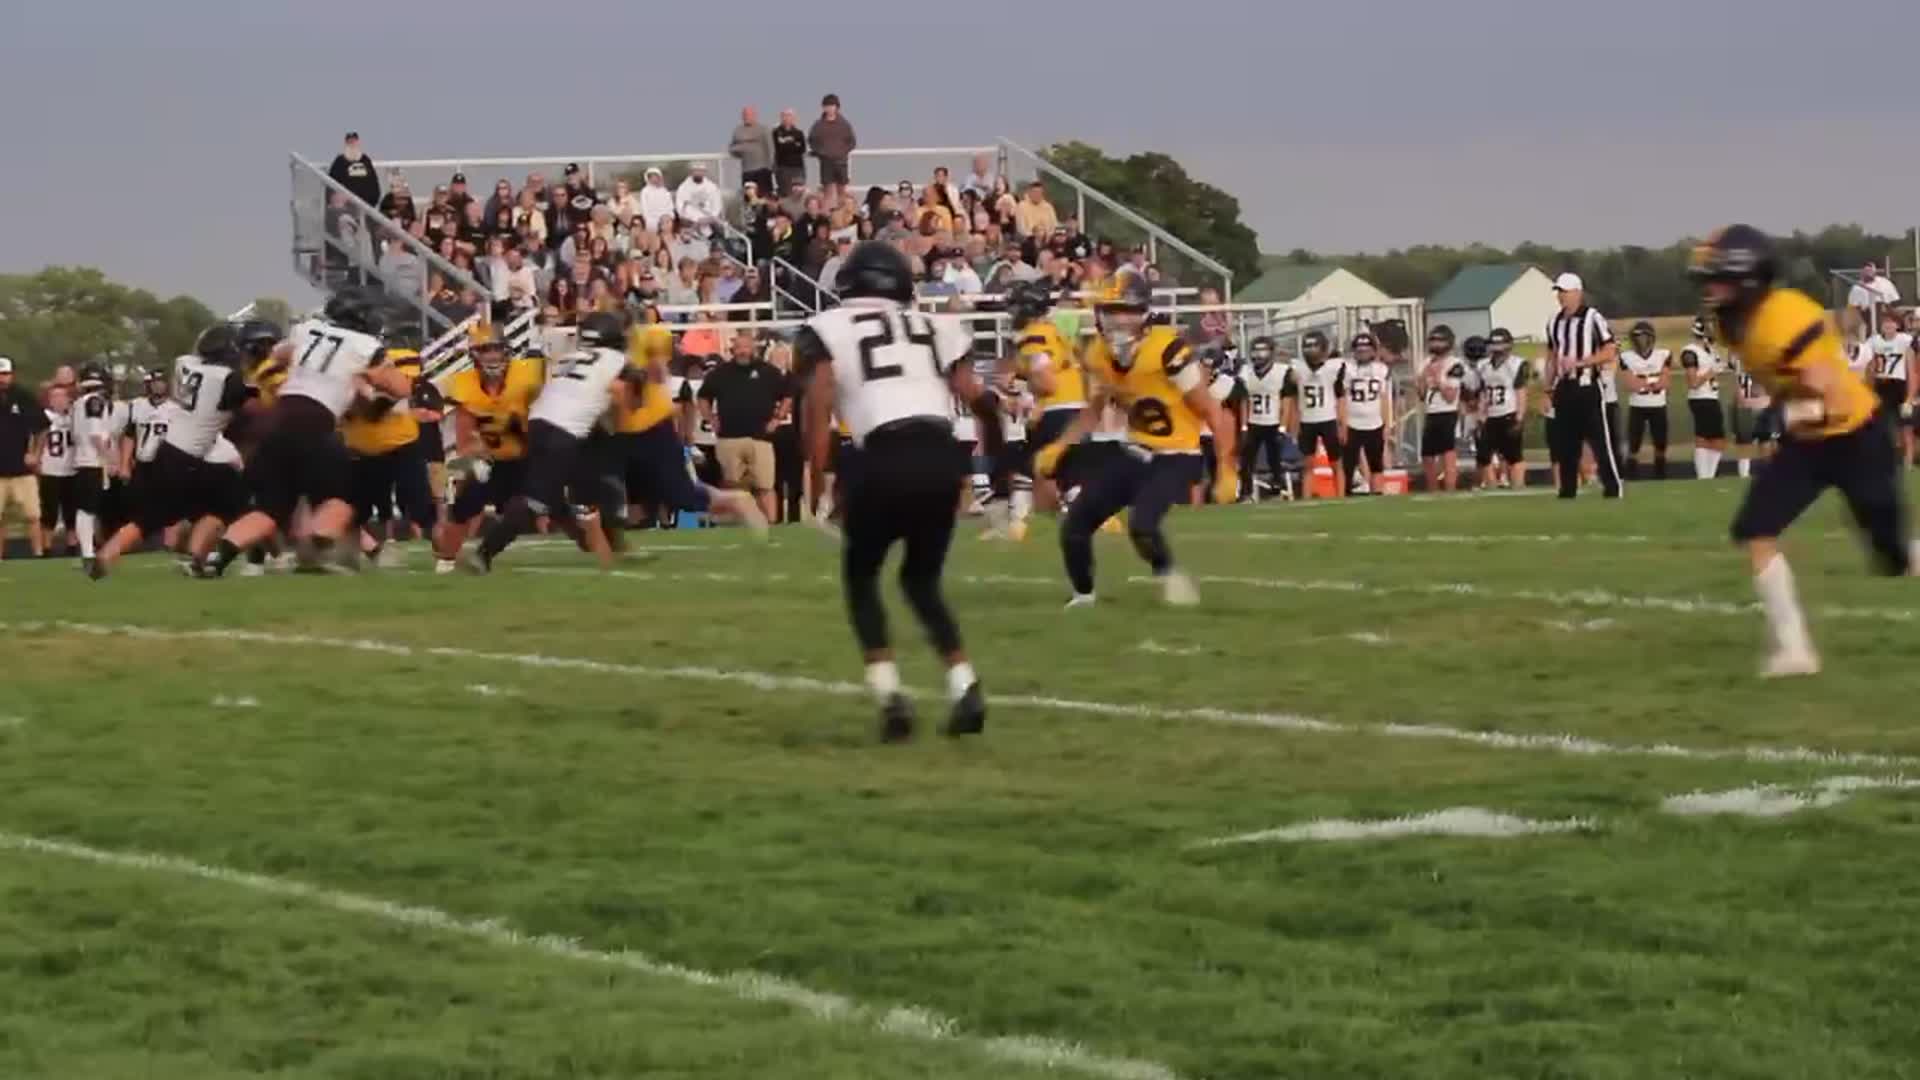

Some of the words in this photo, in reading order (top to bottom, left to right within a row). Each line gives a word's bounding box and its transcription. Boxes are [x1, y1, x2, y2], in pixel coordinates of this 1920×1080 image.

[299, 329, 344, 373] 77
[851, 311, 946, 382] 24
[1252, 394, 1271, 415] 21
[1303, 384, 1325, 408] 51
